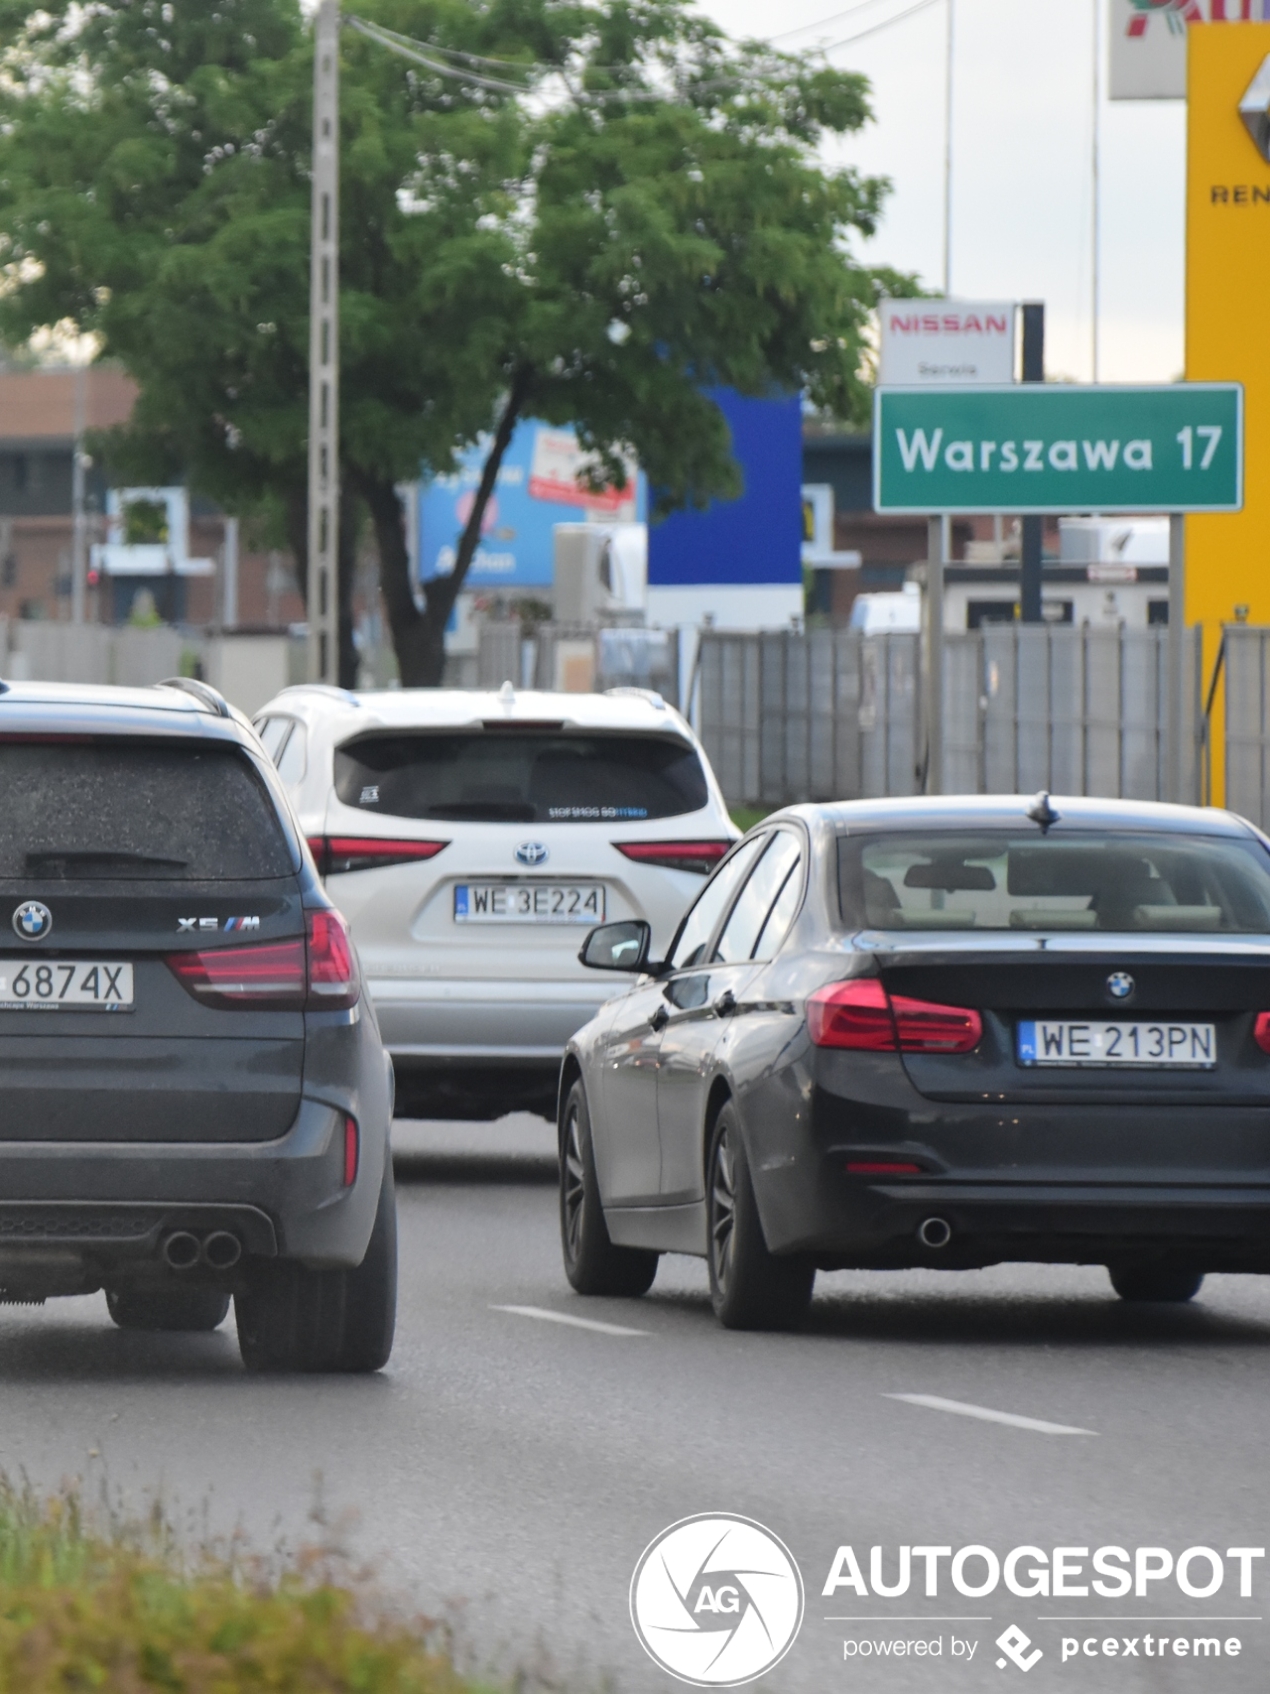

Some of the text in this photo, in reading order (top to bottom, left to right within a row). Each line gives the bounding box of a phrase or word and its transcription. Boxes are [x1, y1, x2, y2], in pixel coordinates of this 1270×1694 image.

[890, 314, 1007, 335] NISSAN
[896, 425, 1223, 472] Warszawa 17
[474, 888, 598, 914] WE 3E224
[176, 917, 219, 932] X5
[12, 965, 123, 1000] 6874X
[1043, 1025, 1211, 1058] WE 213PN
